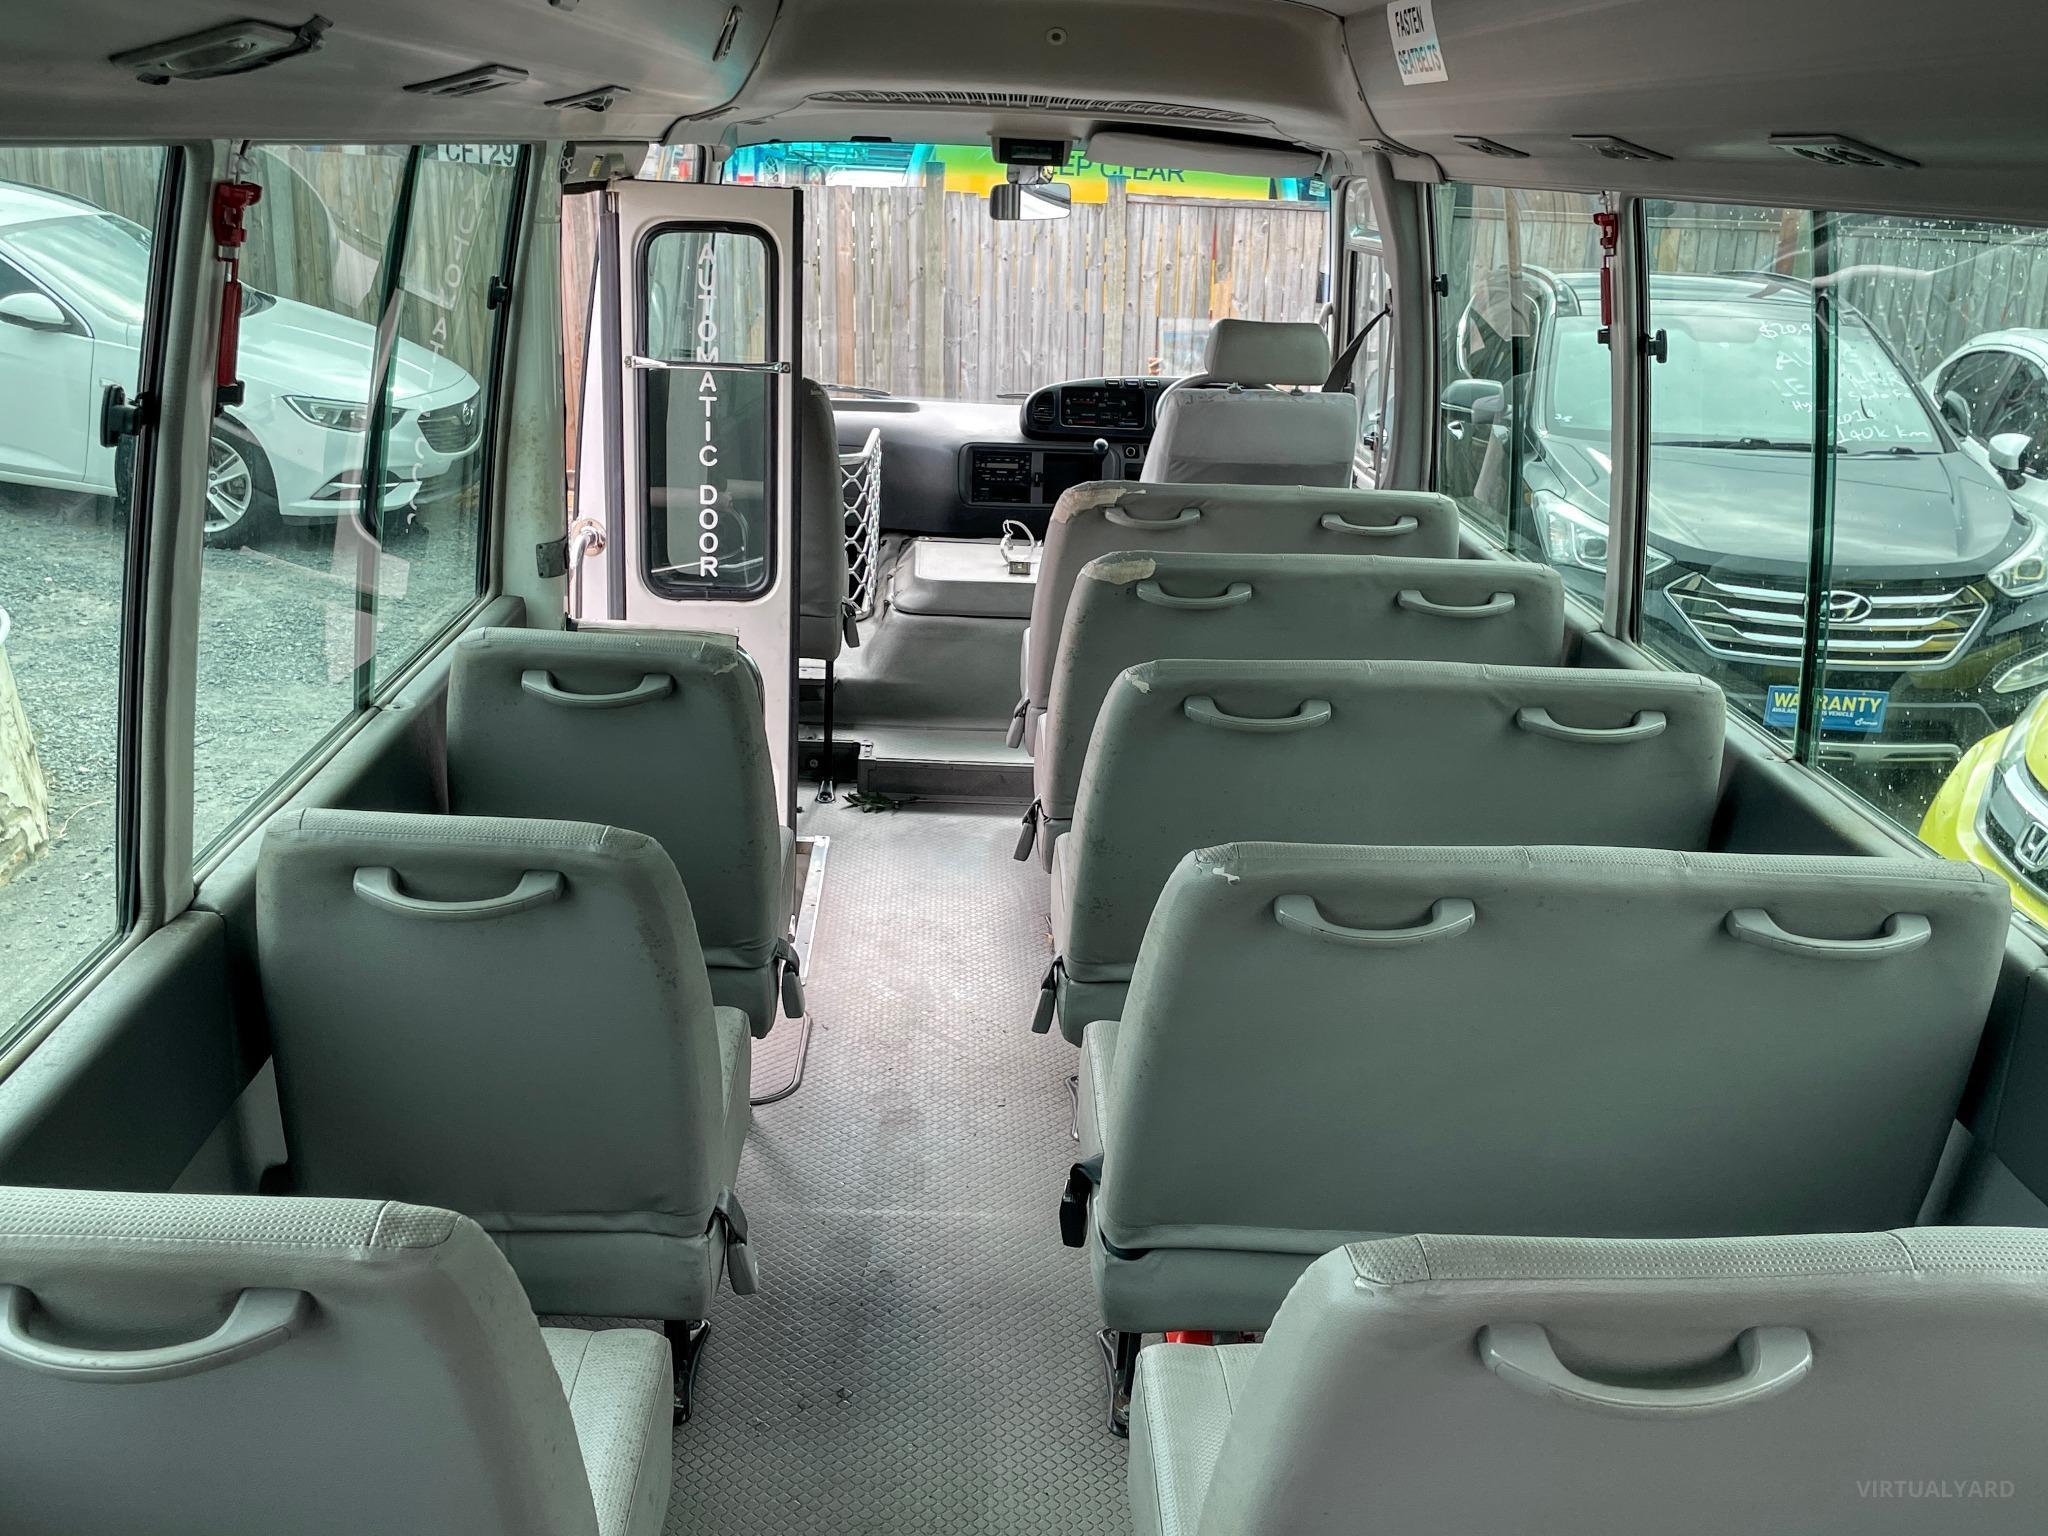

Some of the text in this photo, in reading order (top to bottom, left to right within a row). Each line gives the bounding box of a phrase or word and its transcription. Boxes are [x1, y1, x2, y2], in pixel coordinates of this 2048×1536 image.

[1394, 6, 1425, 38] FASTEN
[1398, 44, 1442, 76] SEATBELTS
[696, 243, 720, 578] AUTOMATIC DOOR
[1774, 691, 1882, 713] WARANTY
